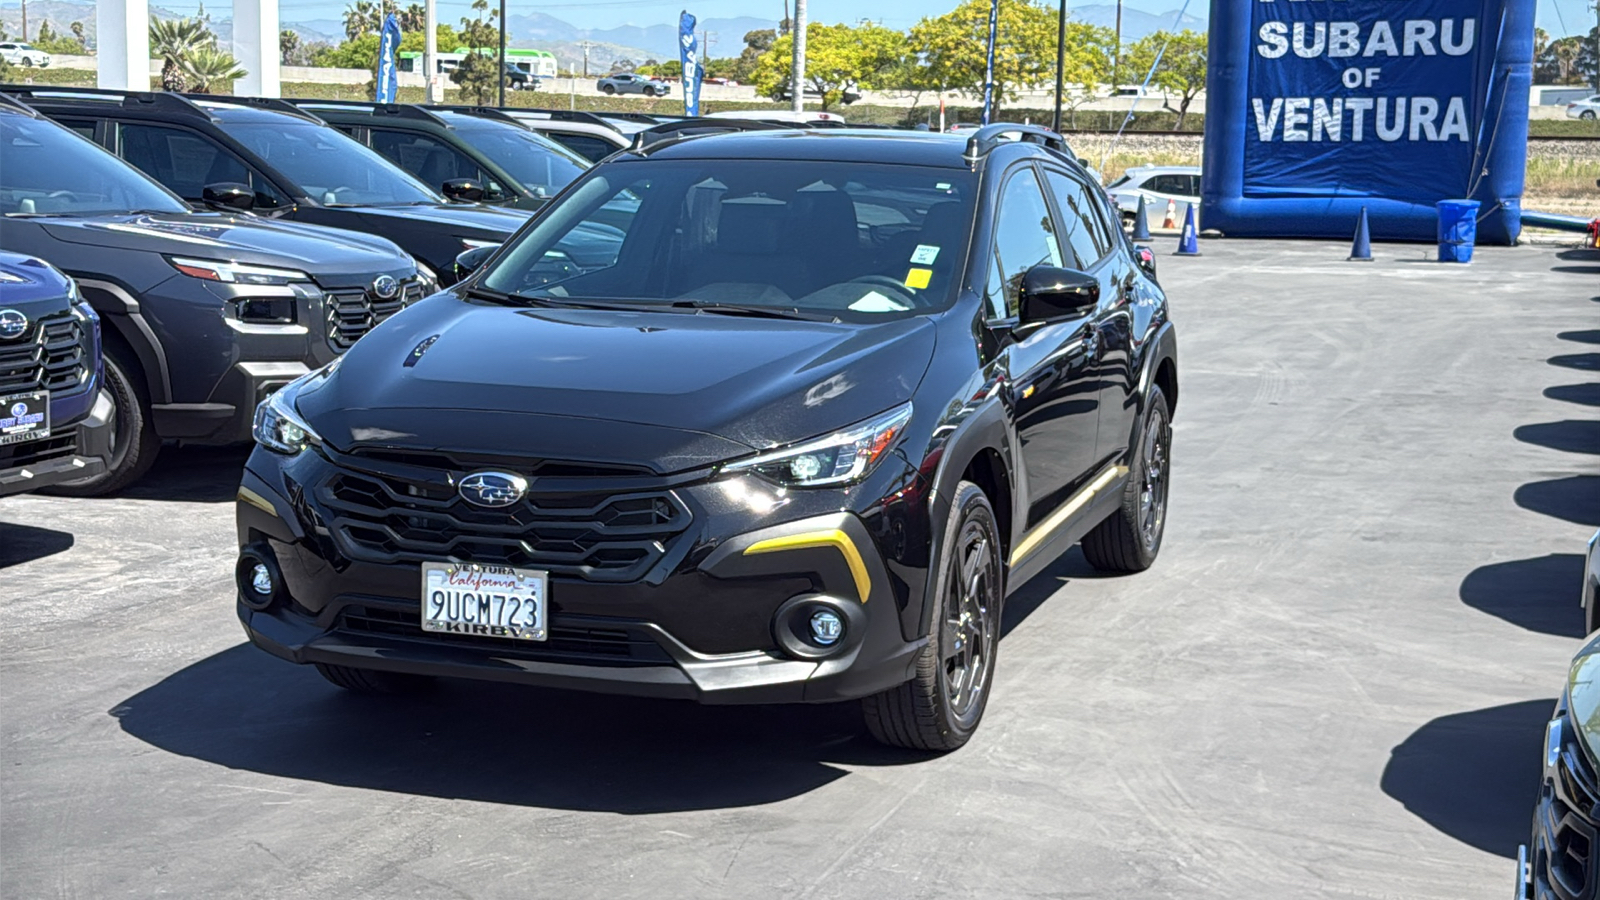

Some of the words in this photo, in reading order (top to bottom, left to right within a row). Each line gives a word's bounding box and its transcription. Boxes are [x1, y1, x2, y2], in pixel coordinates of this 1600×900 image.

[1257, 18, 1476, 58] SUBARU
[1342, 67, 1381, 89] OF
[1251, 96, 1470, 142] VENTURA
[453, 563, 516, 575] VENTURA
[449, 570, 524, 591] California
[432, 590, 538, 628] 9UCM723
[446, 622, 523, 637] KIRBY
